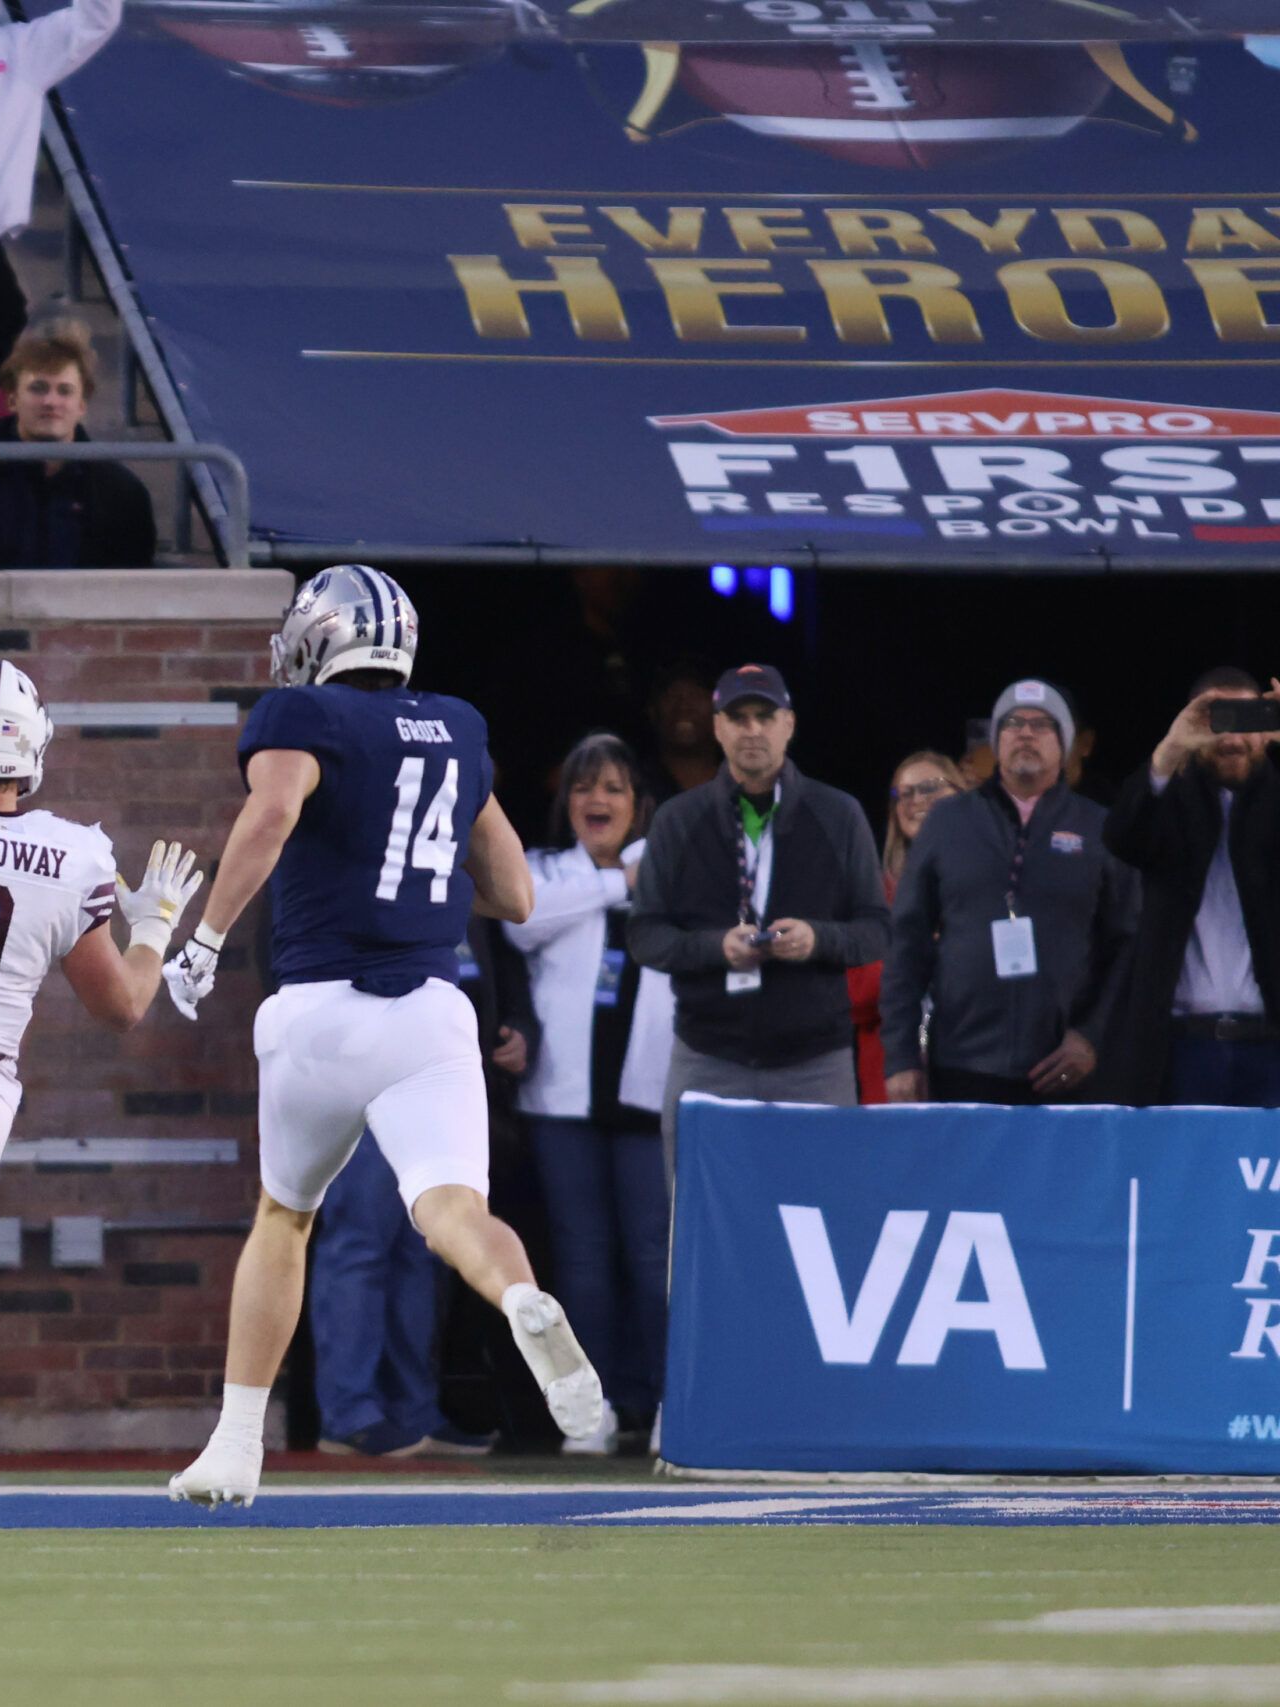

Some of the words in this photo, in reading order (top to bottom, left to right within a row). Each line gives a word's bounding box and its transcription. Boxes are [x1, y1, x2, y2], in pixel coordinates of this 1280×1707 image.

[502, 203, 1280, 253] EVERYDA
[806, 411, 1213, 433] SERVPRO
[685, 491, 1280, 520] RESPOND
[936, 518, 1181, 541] BOWL
[395, 716, 453, 743] GROEN
[0, 765, 17, 774] UP
[375, 756, 460, 903] 14
[778, 1204, 1047, 1370] VA
